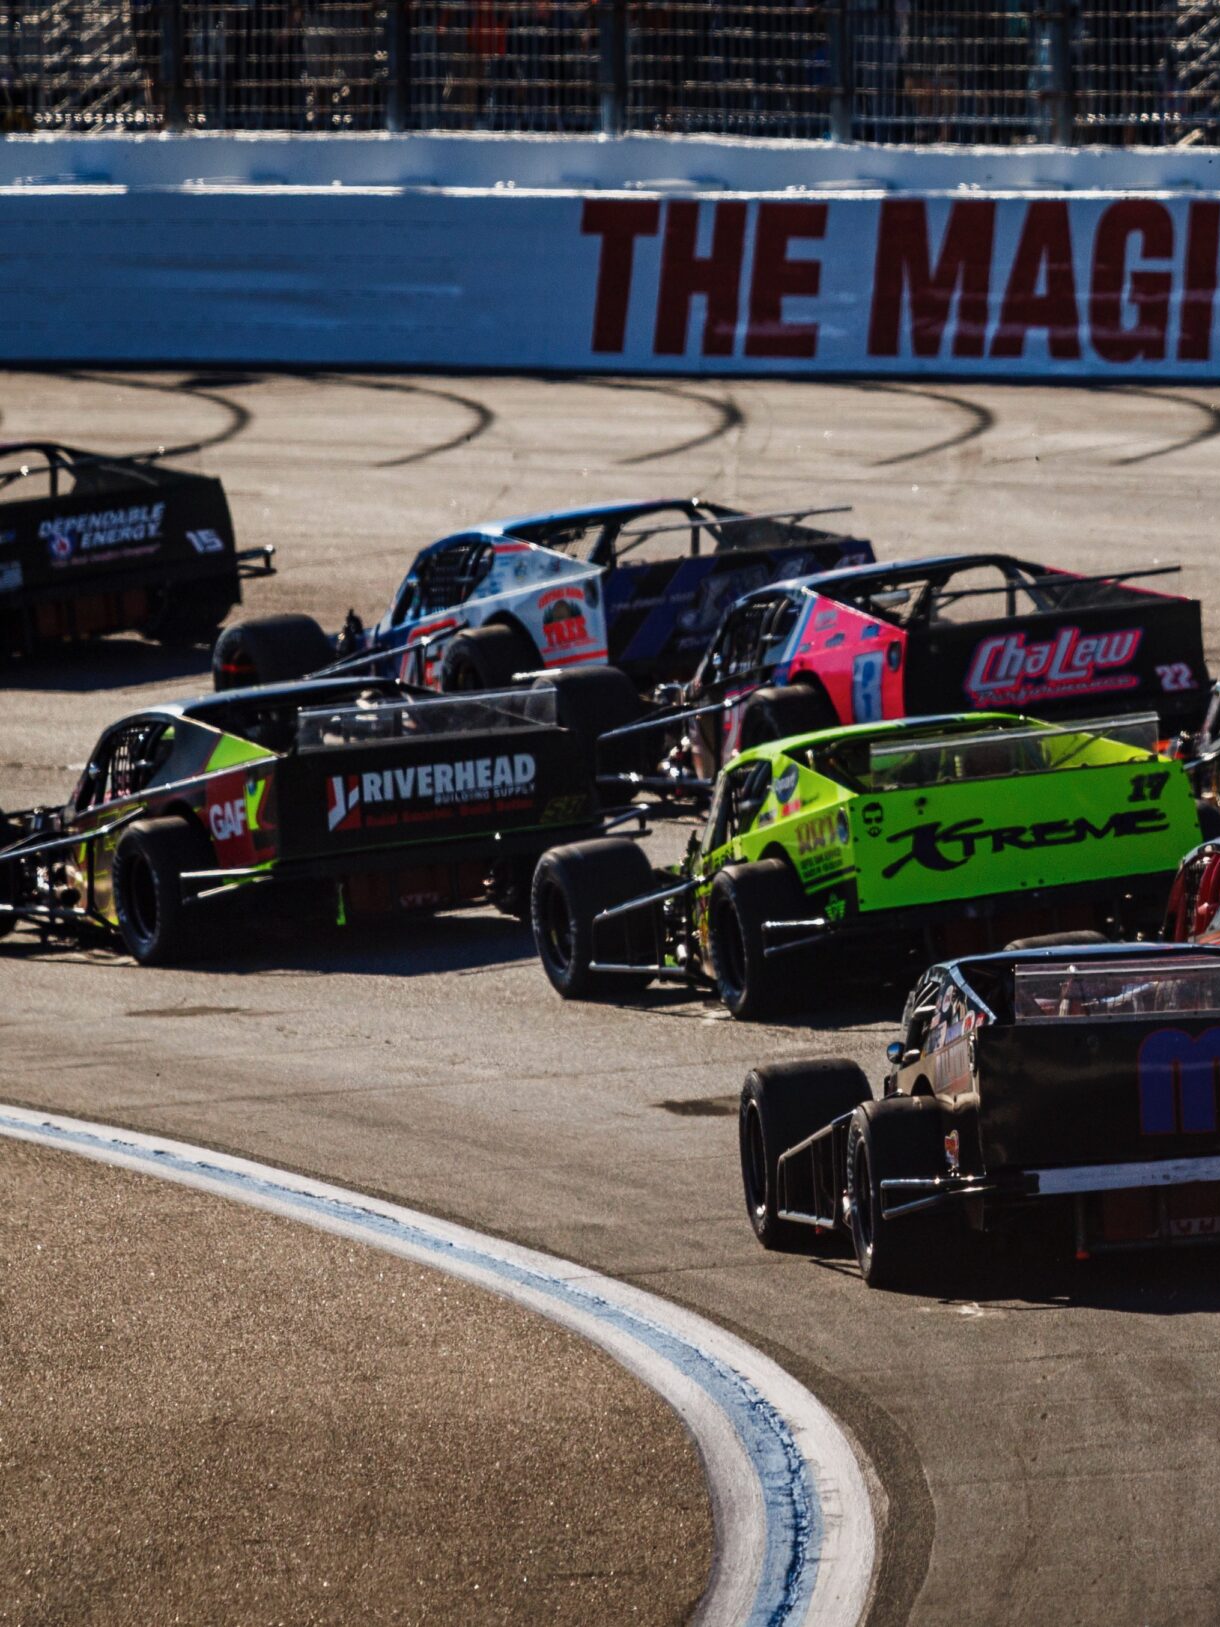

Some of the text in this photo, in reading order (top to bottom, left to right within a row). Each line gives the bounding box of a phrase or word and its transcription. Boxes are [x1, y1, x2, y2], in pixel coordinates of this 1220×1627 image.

[580, 198, 829, 359] THE
[37, 501, 167, 539] DEPENDABLE
[80, 522, 162, 549] ENERGY
[184, 527, 225, 554] 15
[965, 626, 1141, 692] ChaLew
[1154, 661, 1196, 692] 22
[360, 752, 538, 804] RIVERHEAD
[1127, 771, 1170, 803] 17
[209, 797, 247, 841] GAF
